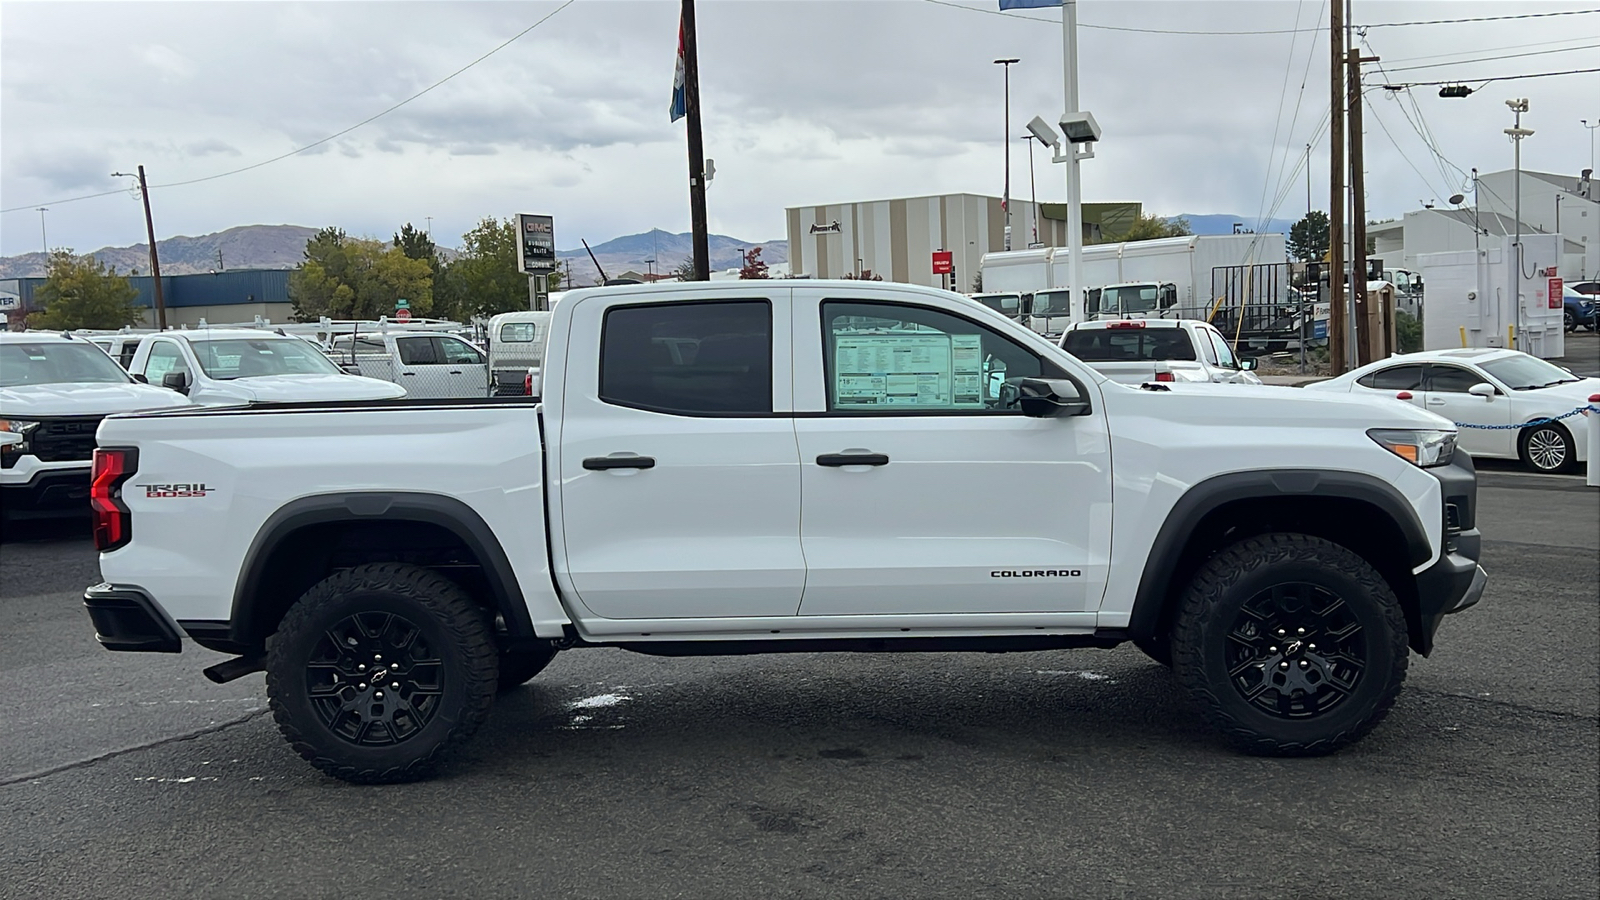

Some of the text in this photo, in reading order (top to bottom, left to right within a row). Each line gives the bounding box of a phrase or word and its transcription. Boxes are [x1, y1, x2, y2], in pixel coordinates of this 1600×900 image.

[526, 222, 551, 233] GMC
[135, 483, 216, 492] TRAIL
[990, 569, 1081, 578] COLORADO
